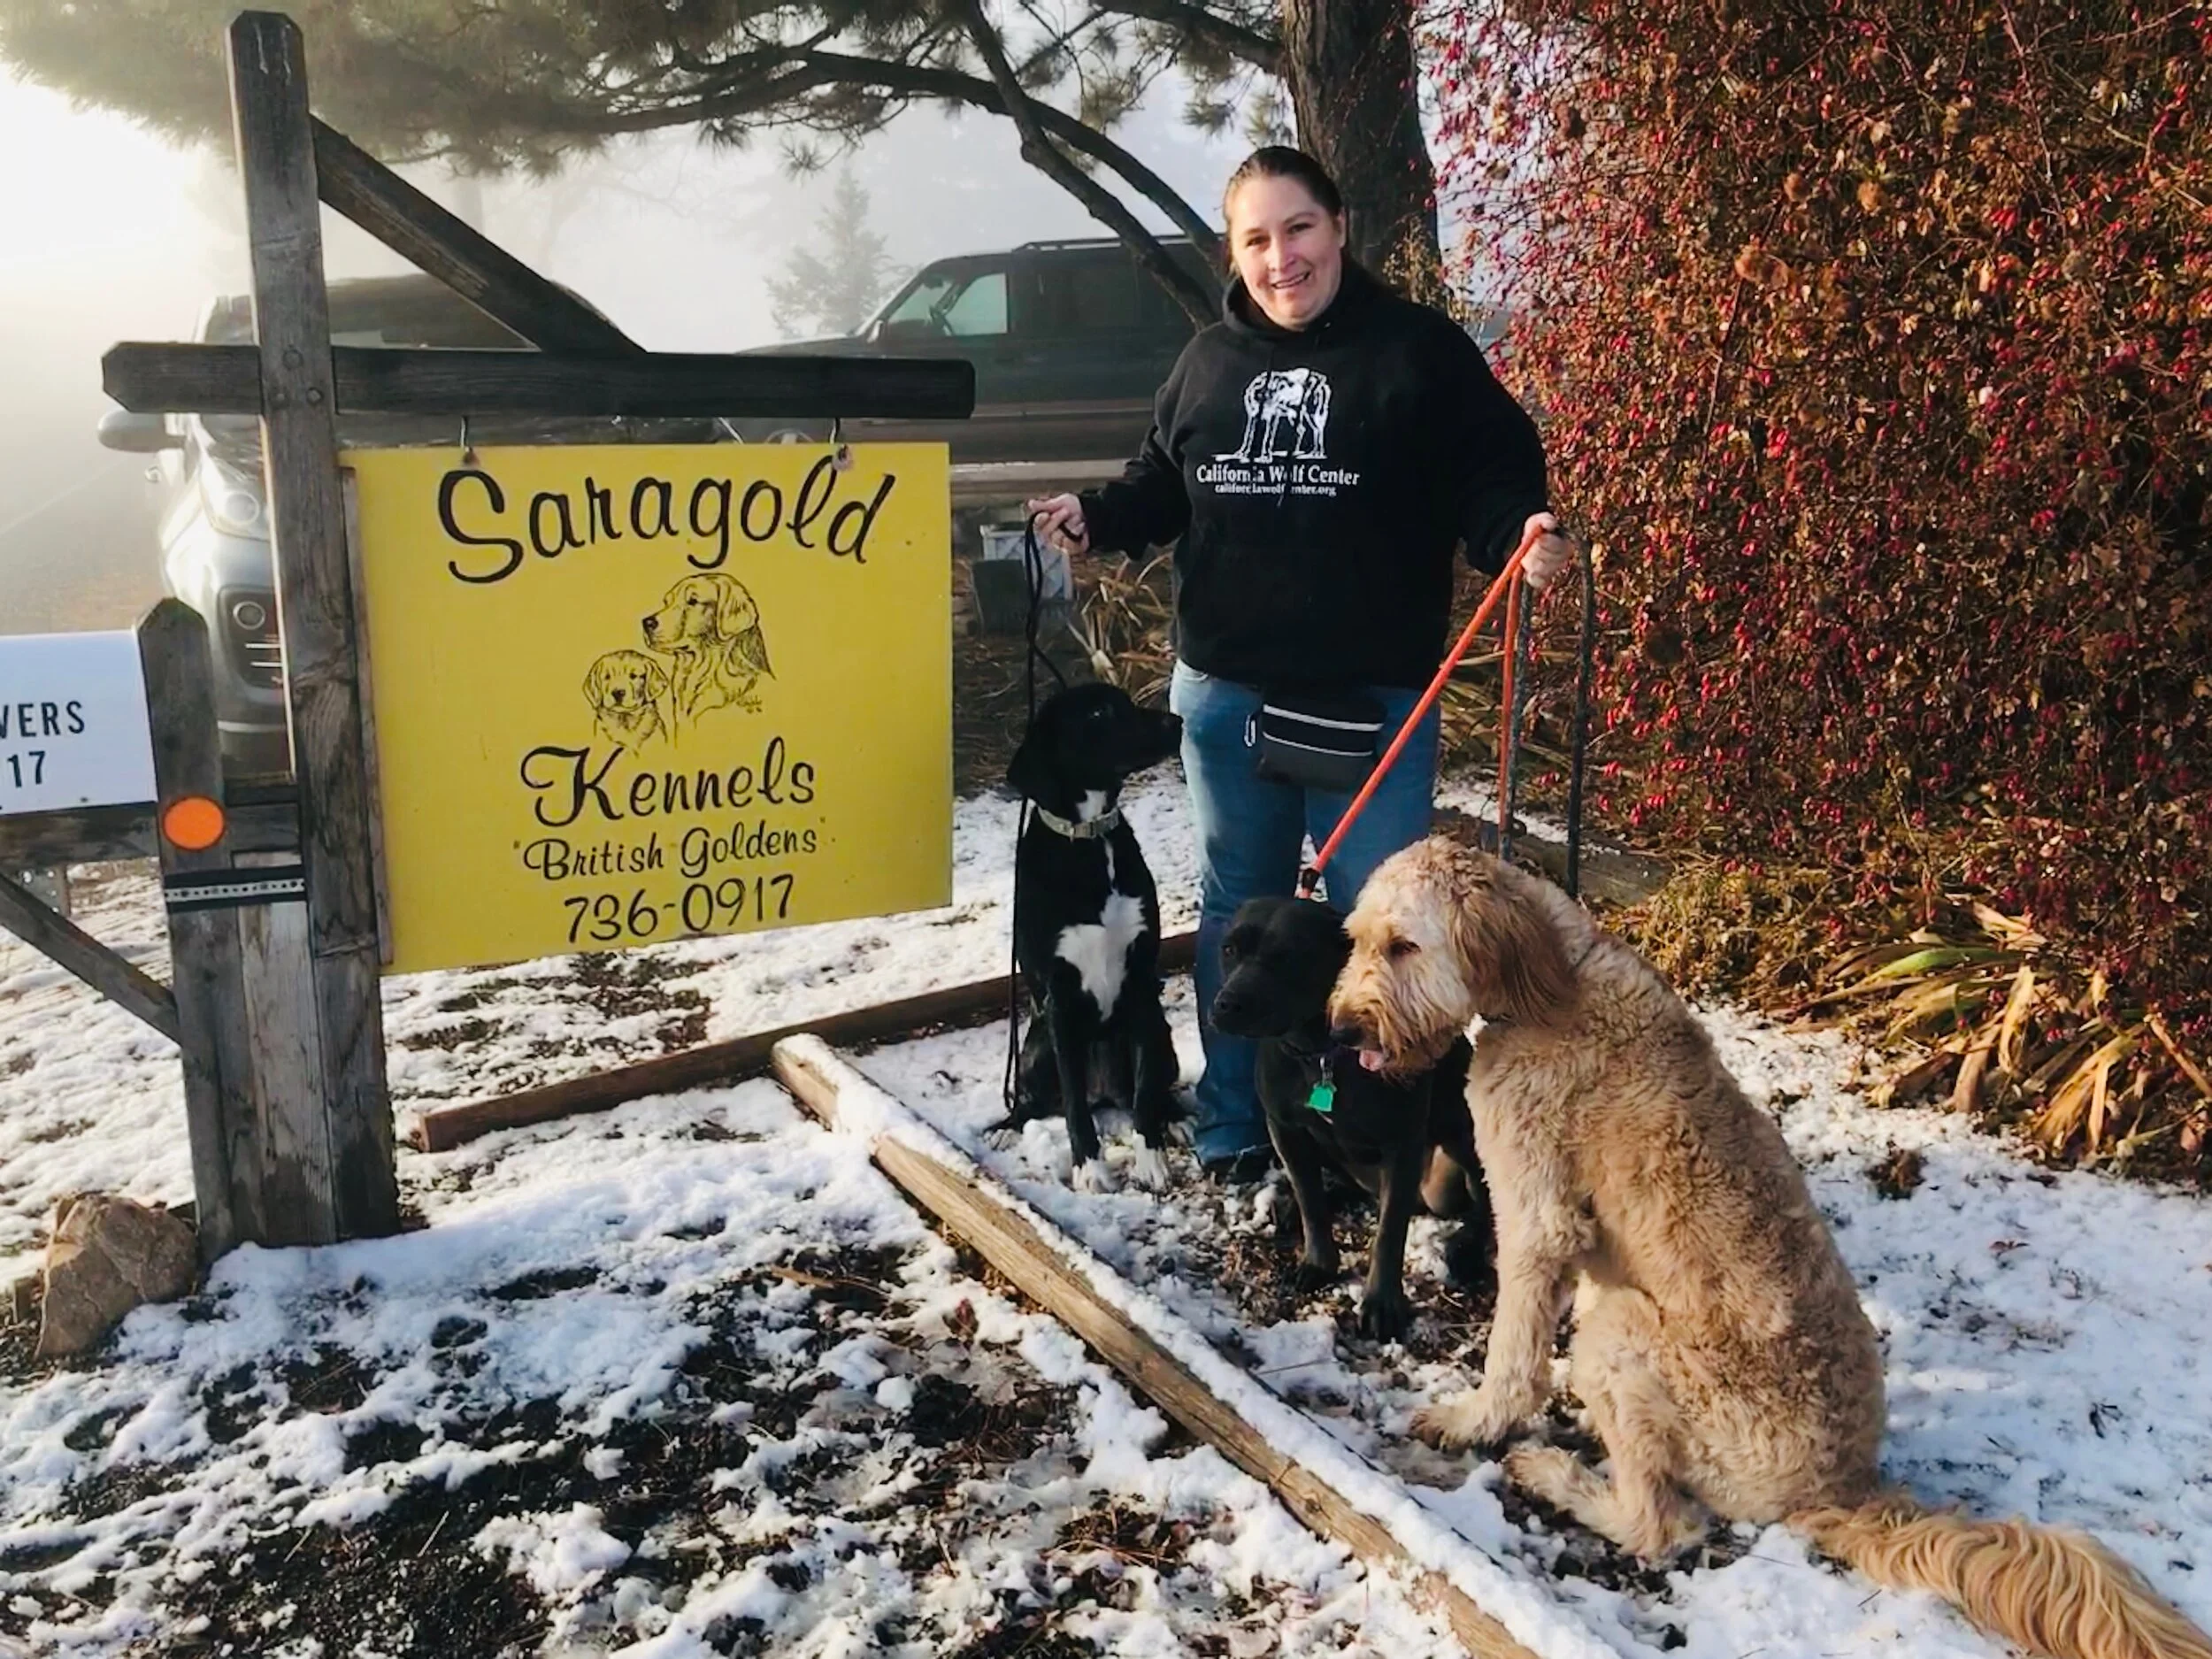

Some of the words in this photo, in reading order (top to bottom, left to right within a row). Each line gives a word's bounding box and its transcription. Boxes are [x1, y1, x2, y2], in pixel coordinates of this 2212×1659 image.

[1308, 465, 1360, 486] Center
[437, 454, 895, 583] Saragold
[520, 737, 814, 826] Kennels
[564, 873, 795, 943] 736-0917
